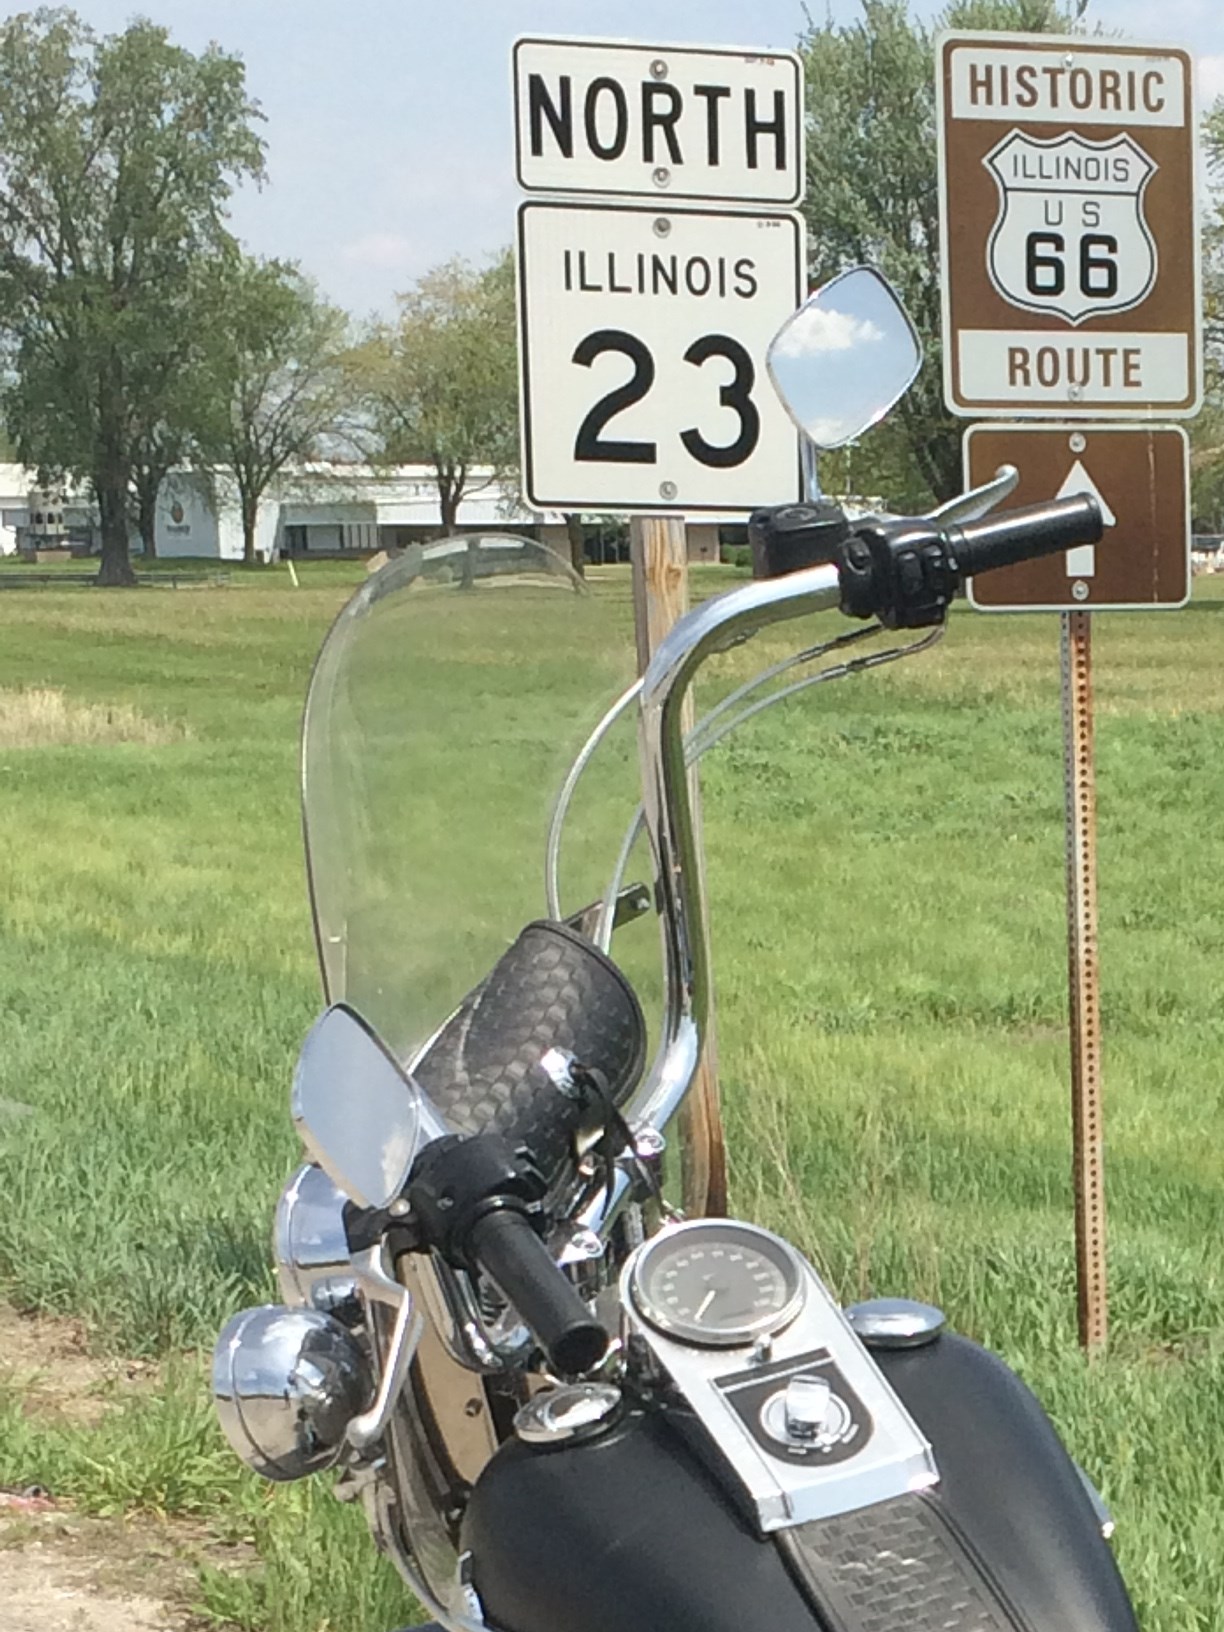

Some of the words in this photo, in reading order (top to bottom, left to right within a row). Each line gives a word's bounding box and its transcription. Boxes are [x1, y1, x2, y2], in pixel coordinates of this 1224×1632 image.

[969, 64, 1166, 113] HISTORIC
[528, 74, 787, 171] NORTH
[1012, 155, 1130, 184] ILLINOIS
[564, 250, 758, 298] ILLINOIS
[1025, 231, 1119, 299] 66
[1007, 346, 1143, 388] ROUTE
[571, 330, 760, 469] 23
